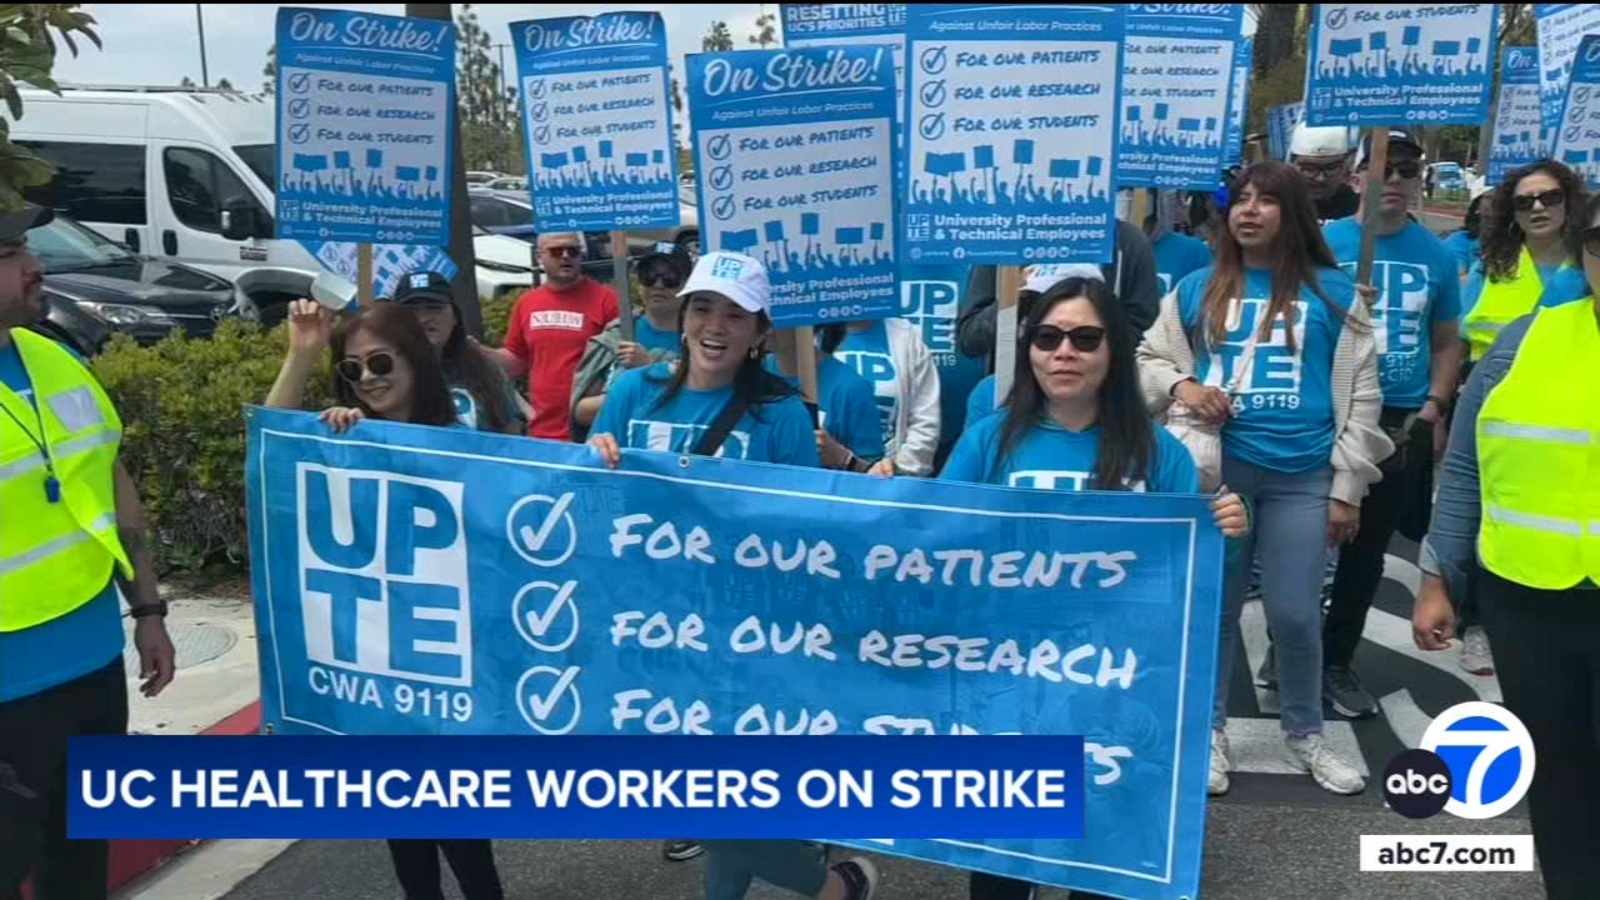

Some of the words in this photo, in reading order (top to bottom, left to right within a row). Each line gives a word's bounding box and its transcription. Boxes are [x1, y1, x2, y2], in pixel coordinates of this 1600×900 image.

[787, 4, 886, 20] RESETTING
[1354, 10, 1381, 22] FOR
[1384, 8, 1411, 20] OUR
[1416, 5, 1479, 18] STUDENTS
[290, 12, 338, 41] On
[342, 17, 448, 52] Strike!
[525, 24, 566, 51] On
[566, 14, 653, 47] Strike!
[818, 17, 886, 31] PRIORITIES
[929, 21, 974, 32] Against
[977, 20, 1014, 31] Unfair
[1016, 20, 1048, 31] Labor
[1050, 21, 1103, 31] Practices
[955, 52, 987, 67] FOR
[994, 52, 1026, 65] OUR
[1031, 50, 1100, 64] PATIENTS
[1144, 46, 1167, 54] OUR
[1171, 46, 1222, 55] PATIENTS
[704, 58, 758, 96] On
[762, 48, 884, 92] Strike!
[1141, 67, 1164, 75] OUR
[1166, 67, 1219, 76] RESEARCH
[317, 79, 343, 92] FOR
[349, 82, 375, 94] OUR
[378, 84, 434, 97] PATIENTS
[551, 81, 573, 93] FOR
[576, 79, 598, 90] OUR
[601, 73, 651, 87] PATIENTS
[954, 87, 986, 100] FOR
[991, 85, 1022, 98] OUR
[1027, 83, 1100, 97] RESEARCH
[1335, 86, 1400, 96] University
[1401, 83, 1484, 94] Professional
[1140, 89, 1162, 97] OUR
[1165, 89, 1216, 97] STUDENTS
[1347, 97, 1407, 107] Technical
[1410, 96, 1480, 107] Employees
[317, 105, 344, 116] FOR
[346, 107, 373, 118] OUR
[376, 108, 435, 120] RESEARCH
[554, 105, 574, 115] FOR
[577, 102, 599, 113] OUR
[603, 97, 654, 110] RESEARCH
[712, 107, 753, 121] Against
[756, 105, 789, 118] Unfair
[792, 103, 822, 115] Labor
[824, 101, 874, 112] Practices
[556, 127, 577, 139] FOR
[581, 125, 602, 136] OUR
[606, 119, 656, 134] STUDENTS
[953, 118, 986, 132] FOR
[991, 117, 1022, 130] OUR
[1028, 115, 1099, 130] STUDENTS
[317, 128, 343, 141] FOR
[347, 131, 374, 142] OUR
[377, 132, 434, 145] STUDENTS
[739, 137, 771, 151] FOR
[774, 135, 804, 149] OUR
[809, 127, 875, 144] PATIENTS
[1151, 153, 1218, 164] Professional
[742, 168, 772, 182] FOR
[774, 165, 803, 179] OUR
[809, 157, 877, 174] RESEARCH
[1158, 164, 1215, 174] Employees
[552, 194, 604, 205] University
[606, 189, 674, 202] Professional
[744, 197, 773, 211] FOR
[778, 194, 808, 208] OUR
[811, 185, 879, 204] STUDENTS
[302, 202, 366, 216] University
[370, 204, 443, 217] Professional
[564, 203, 614, 215] Technical
[615, 202, 674, 212] Employees
[303, 213, 313, 222] &
[316, 213, 376, 225] Technical
[379, 217, 442, 229] Employees
[934, 215, 1013, 228] University
[1016, 213, 1107, 225] Professional
[934, 229, 945, 240] &
[949, 228, 1023, 240] Technical
[1026, 228, 1105, 241] Employees
[769, 281, 805, 294] ersity
[809, 272, 893, 290] Professional
[769, 291, 816, 306] chnical
[820, 287, 893, 302] Employees
[1252, 394, 1300, 409] 9119
[305, 468, 459, 577] UP
[609, 514, 716, 564] FOR
[734, 533, 840, 579] OUR
[864, 544, 1137, 589] PATIENTS
[305, 569, 463, 680] TE
[610, 611, 709, 652] FOR
[730, 615, 837, 661] OUR
[859, 630, 1138, 689] RESEARCH
[309, 666, 384, 709] CWA
[395, 684, 473, 722] 9119
[610, 689, 714, 735] FOR
[734, 703, 839, 735] OUR
